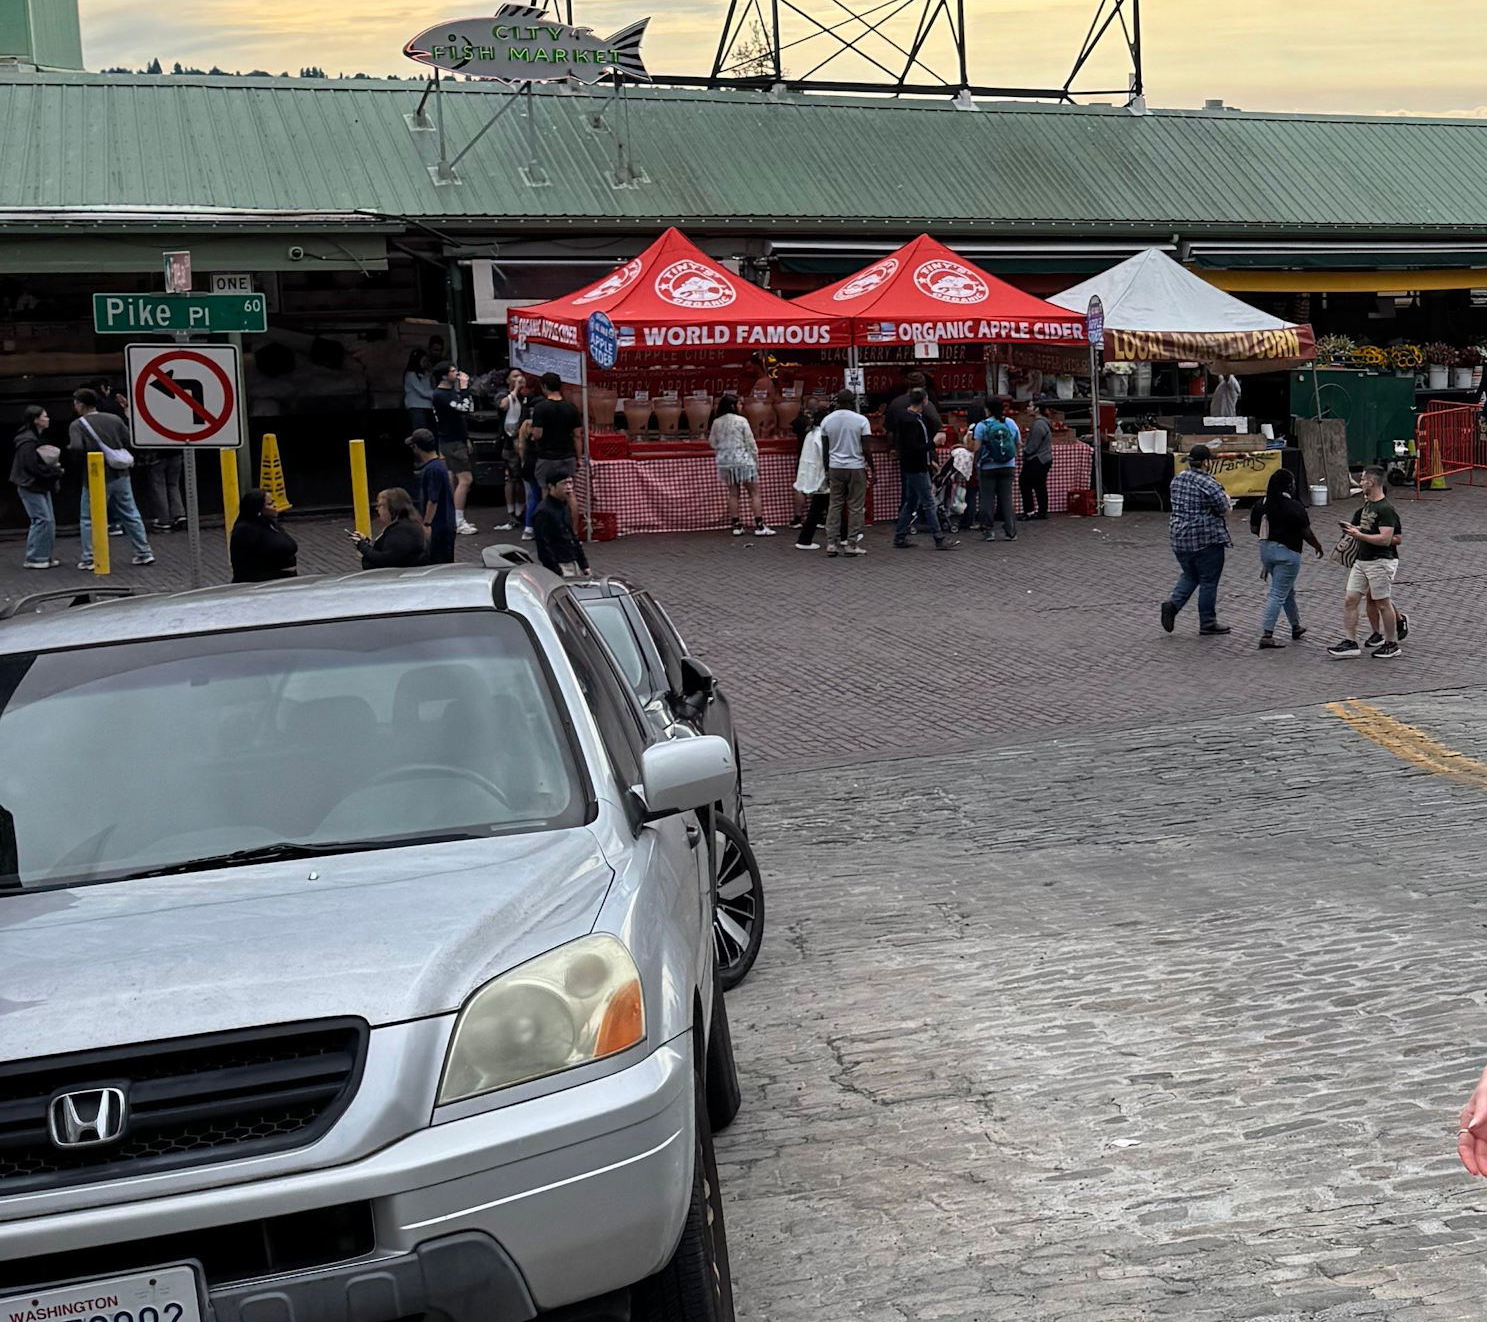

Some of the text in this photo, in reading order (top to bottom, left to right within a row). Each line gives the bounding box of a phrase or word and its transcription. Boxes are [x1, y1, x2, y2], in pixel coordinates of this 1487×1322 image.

[493, 25, 564, 41] CITY
[432, 45, 620, 64] FISH MARKET
[663, 259, 718, 279] TINY'S
[920, 261, 968, 277] TINY'S
[216, 278, 247, 290] ONE
[243, 299, 261, 312] 60
[672, 294, 730, 308] ORGANIC
[932, 291, 985, 304] ORGANIC
[106, 298, 210, 327] Pike Pl
[643, 325, 831, 345] WORLD FAMOUS
[899, 321, 974, 341] ORGANIC
[978, 320, 1031, 339] APPLE
[1033, 322, 1084, 340] CIDER
[590, 333, 614, 354] APPLE
[820, 345, 889, 361] BLACBERRY
[941, 345, 966, 360] IDER
[1112, 330, 1170, 360] LOCAL
[1252, 329, 1300, 359] CORN
[589, 345, 613, 367] CIDER
